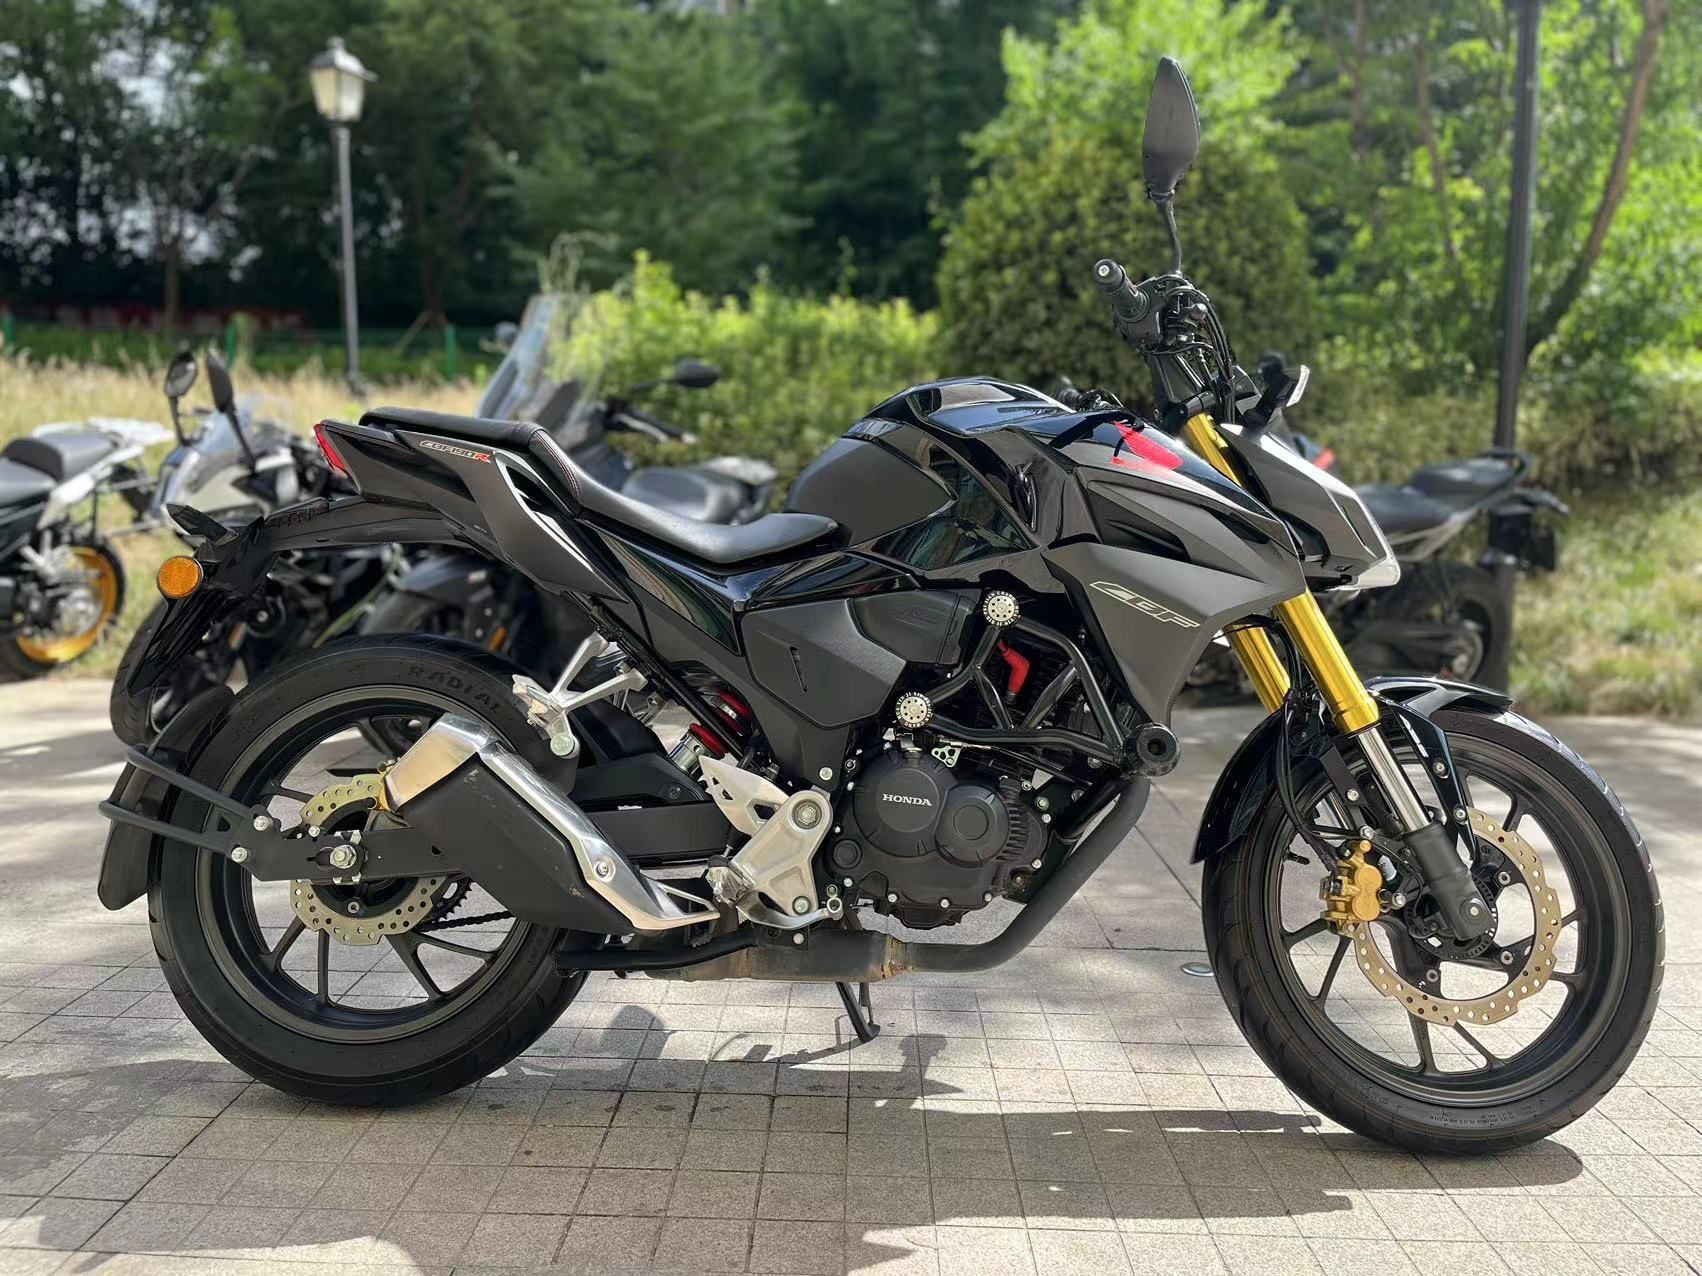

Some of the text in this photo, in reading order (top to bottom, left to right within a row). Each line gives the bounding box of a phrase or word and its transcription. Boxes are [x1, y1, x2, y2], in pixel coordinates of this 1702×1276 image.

[1089, 580, 1201, 628] CBF
[408, 665, 499, 712] RADIAL
[882, 793, 932, 807] HONDA
